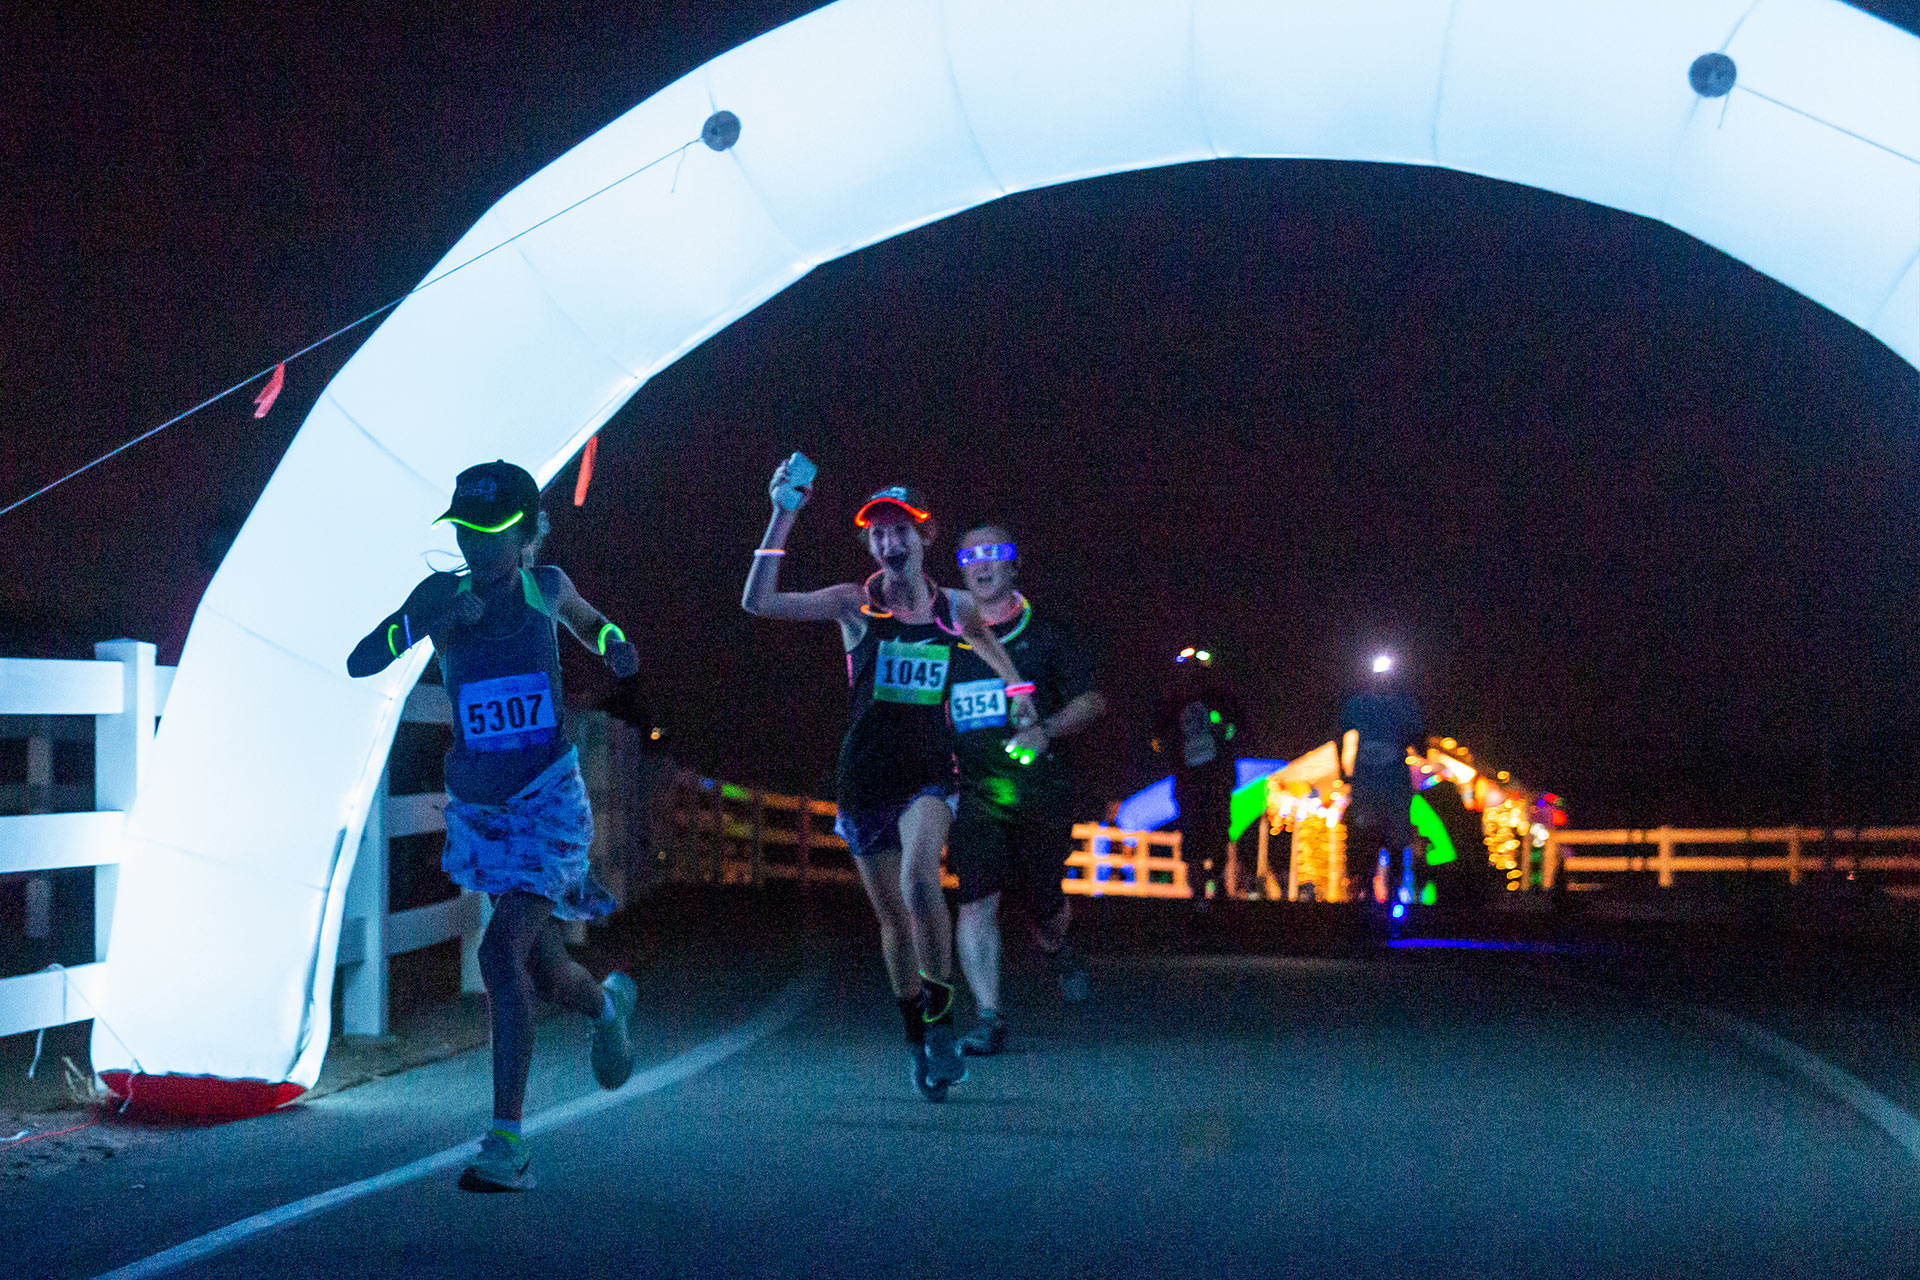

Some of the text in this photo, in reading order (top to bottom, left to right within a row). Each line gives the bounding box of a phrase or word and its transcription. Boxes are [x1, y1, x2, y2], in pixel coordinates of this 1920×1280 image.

[883, 659, 942, 687] 1045
[468, 693, 542, 735] 5307
[954, 693, 999, 718] 5354
